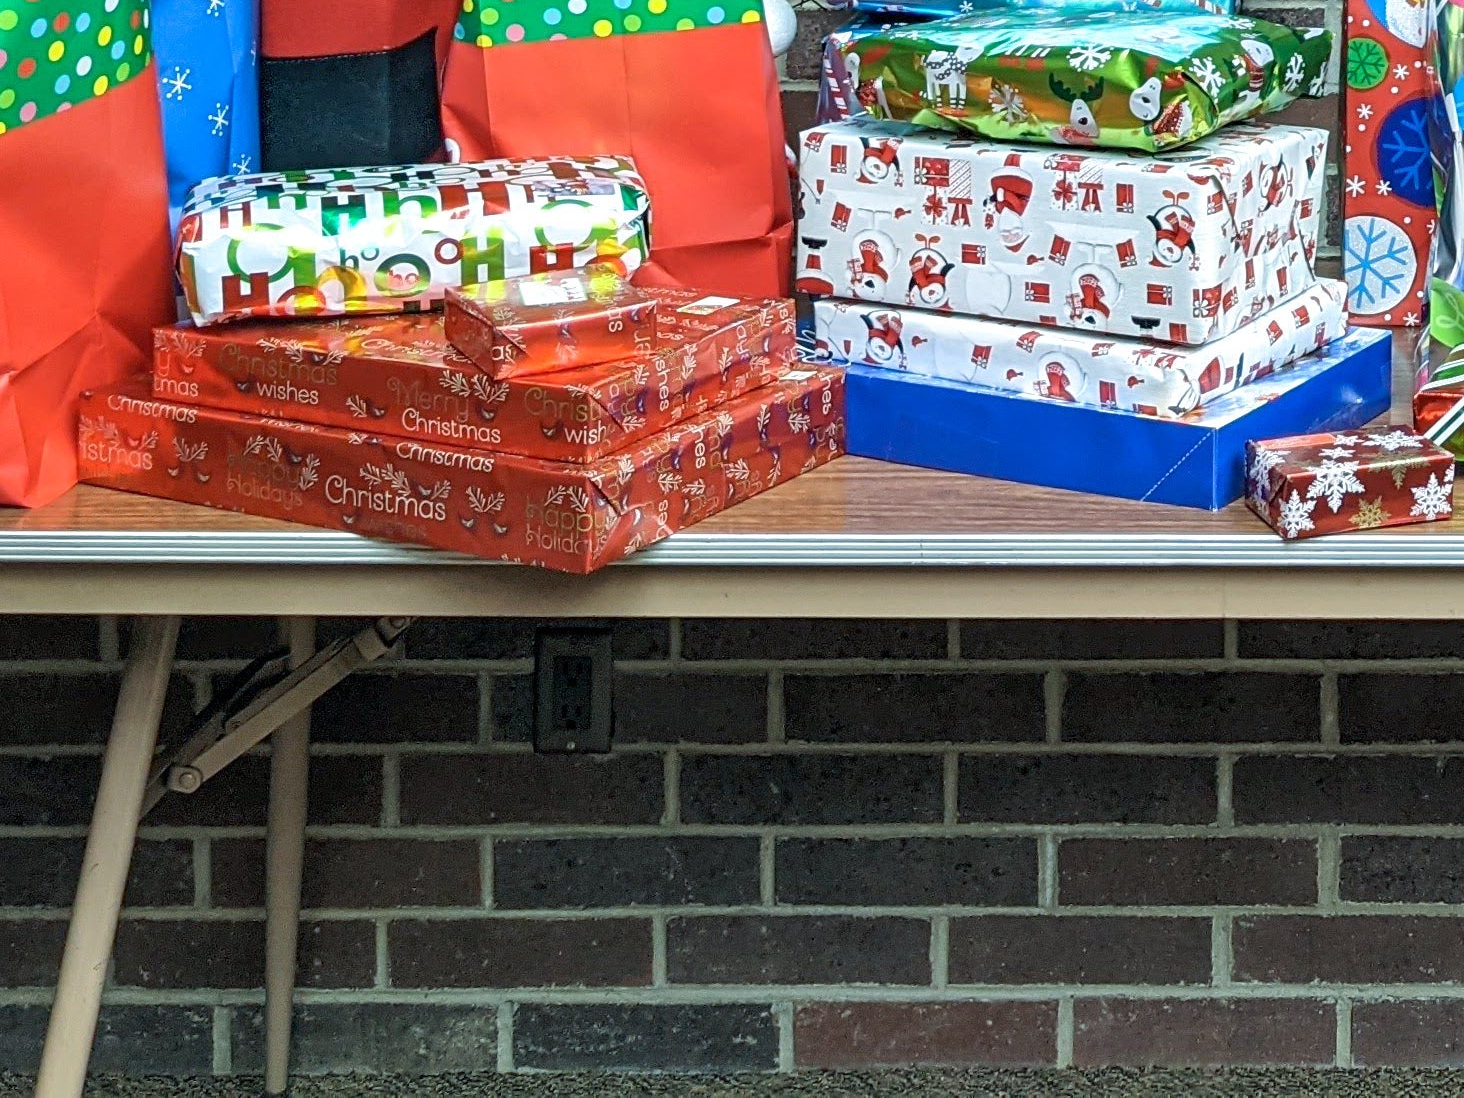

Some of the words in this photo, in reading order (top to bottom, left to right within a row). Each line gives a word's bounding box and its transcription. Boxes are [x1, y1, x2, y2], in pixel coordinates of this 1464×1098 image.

[256, 380, 319, 405] wishes
[401, 407, 501, 444] Christmas
[325, 474, 446, 522] Christmas
